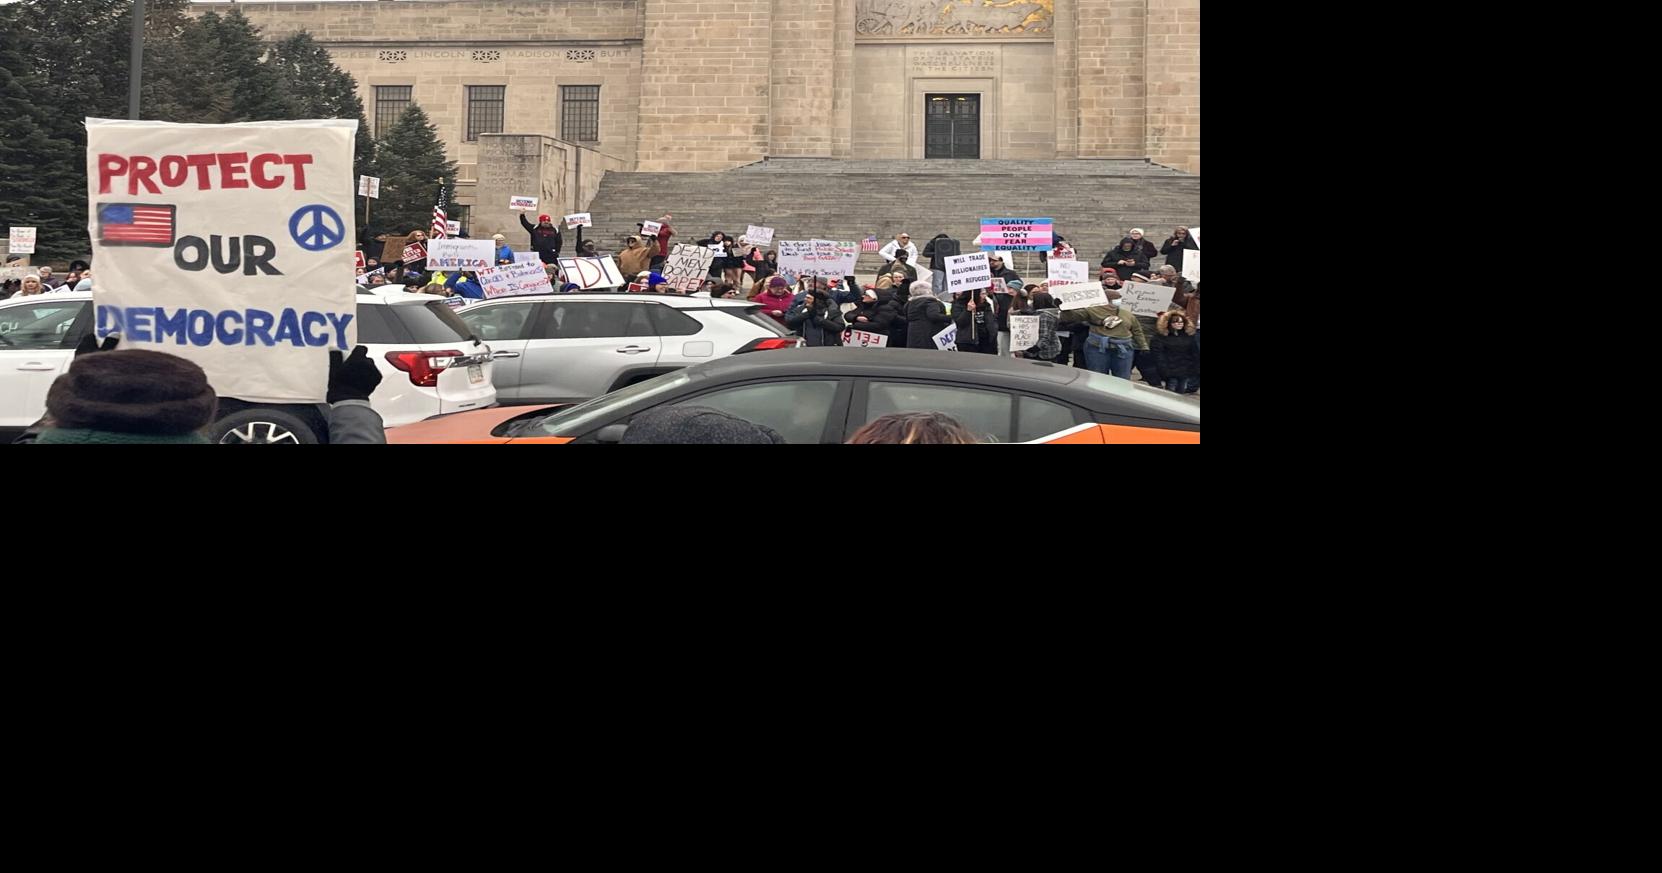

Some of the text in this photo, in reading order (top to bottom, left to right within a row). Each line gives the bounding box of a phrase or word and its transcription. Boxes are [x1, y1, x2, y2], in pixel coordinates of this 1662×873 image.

[600, 50, 629, 58] BURT
[97, 152, 313, 195] PROTECT
[173, 234, 284, 276] OUR
[672, 245, 715, 259] DEAD
[430, 258, 488, 267] AMERICA
[675, 257, 707, 269] MEN
[477, 267, 495, 276] WTF
[951, 264, 988, 275] BILLIONAIRES
[950, 275, 990, 287] FOR REFUGEES
[97, 304, 354, 351] DEMOCRACY
